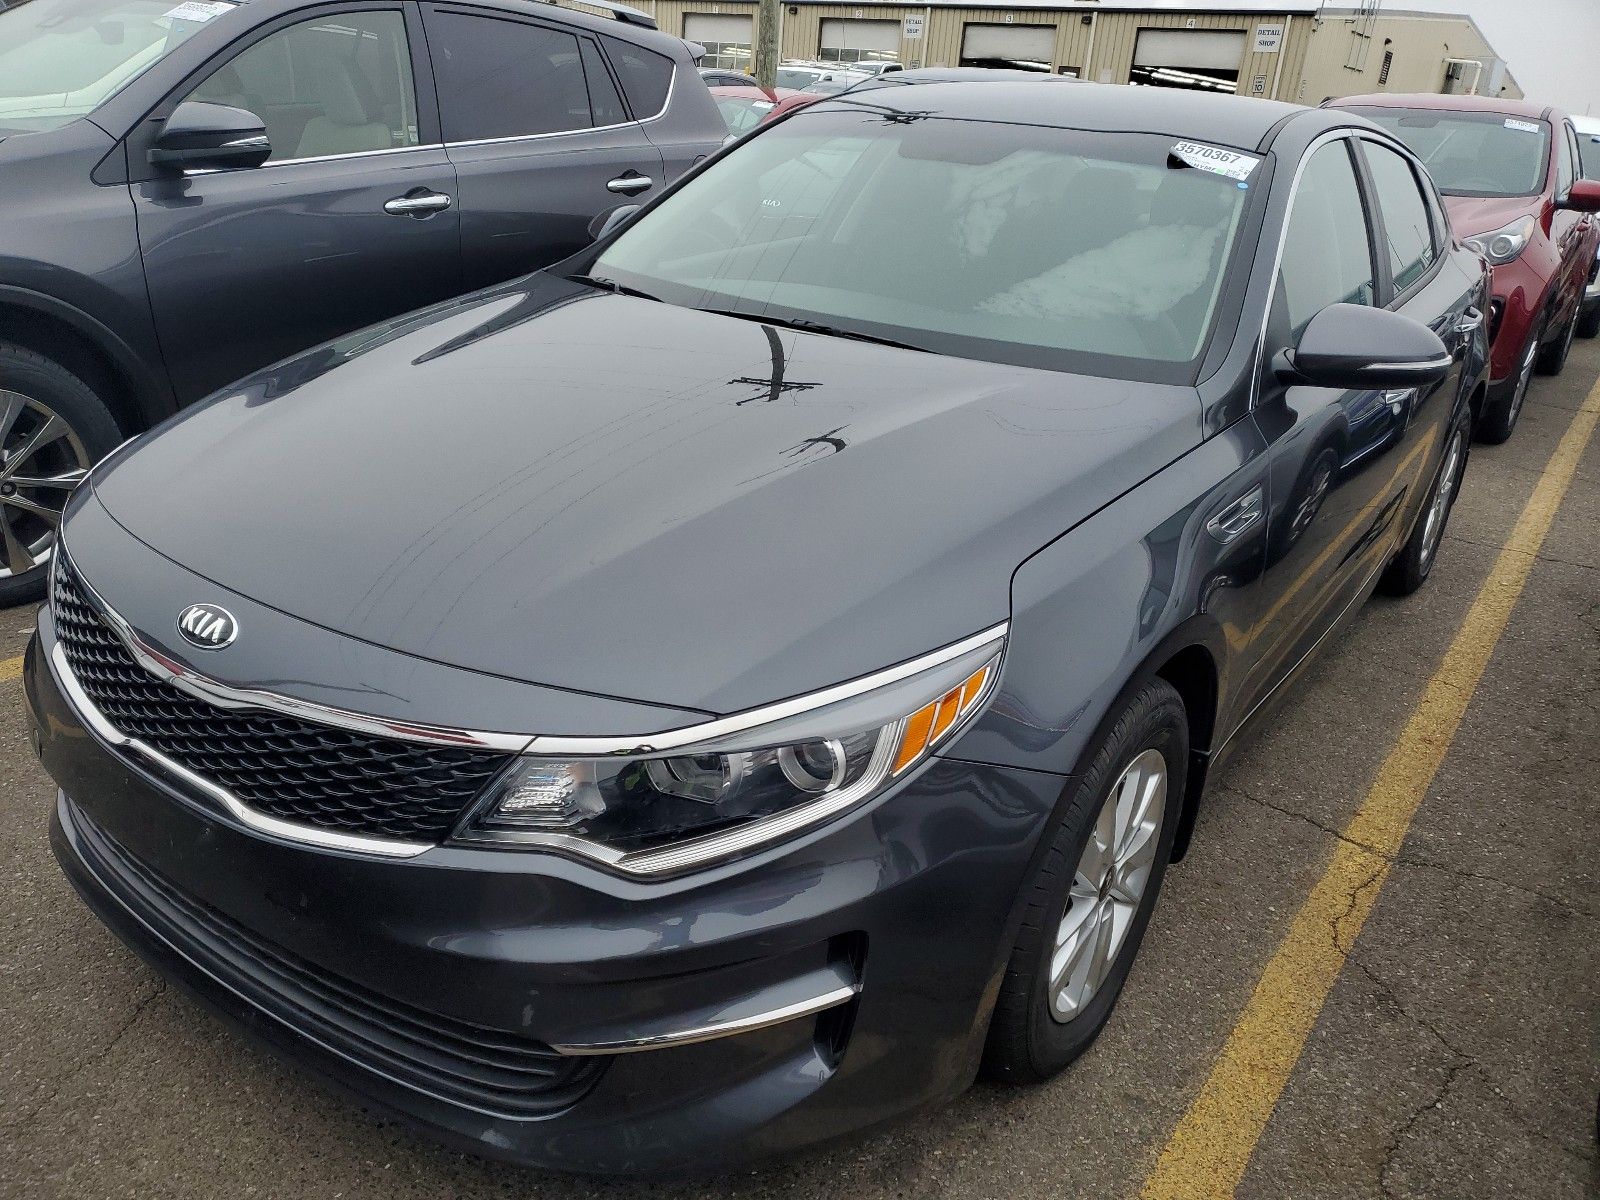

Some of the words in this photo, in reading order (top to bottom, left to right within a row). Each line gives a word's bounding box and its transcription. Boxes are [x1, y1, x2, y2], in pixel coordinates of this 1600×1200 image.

[1254, 84, 1263, 92] 10
[1175, 143, 1241, 164] 3570367
[181, 606, 226, 643] KIA
